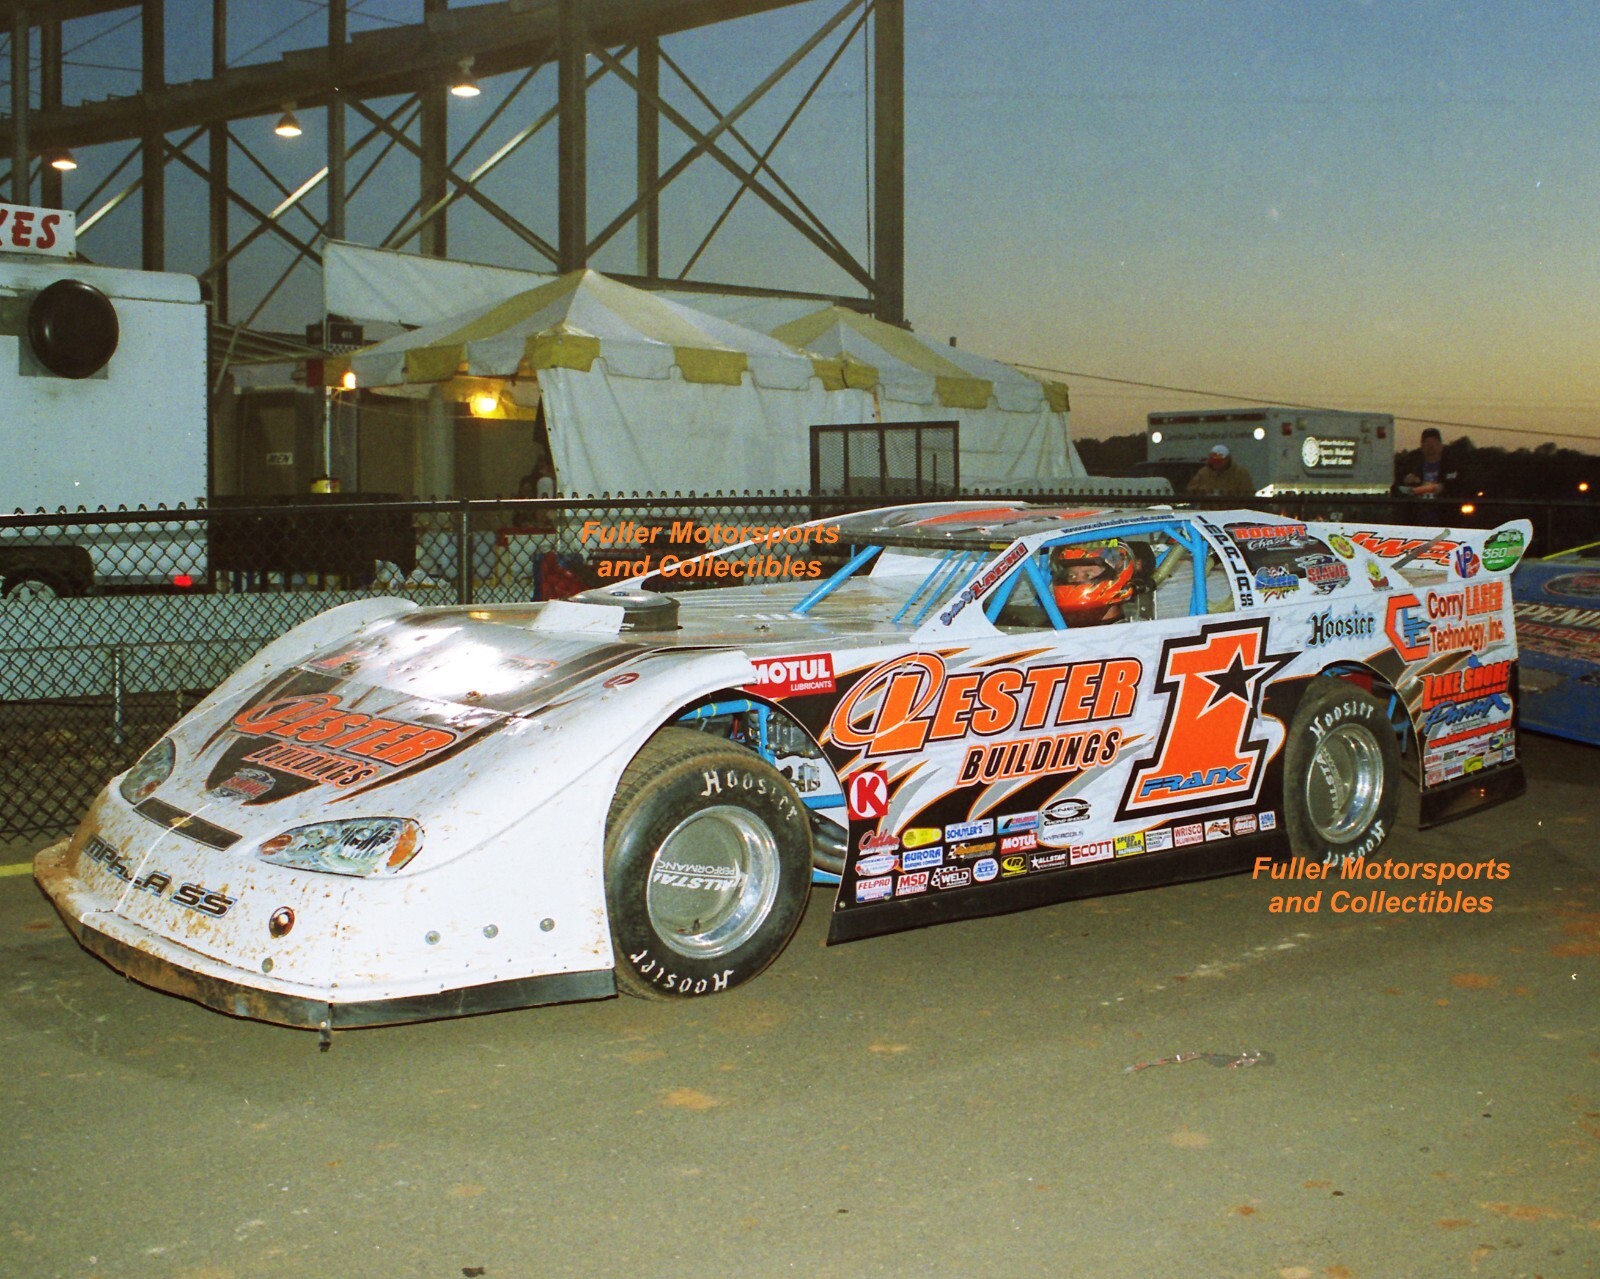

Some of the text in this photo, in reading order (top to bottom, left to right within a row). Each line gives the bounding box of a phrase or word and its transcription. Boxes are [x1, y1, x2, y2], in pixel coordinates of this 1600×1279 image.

[1233, 525, 1307, 540] ROCKET
[1197, 515, 1251, 591] IMPALA
[1482, 547, 1508, 559] 360
[1307, 564, 1349, 582] SLAVIC
[1240, 594, 1254, 607] SS
[1428, 582, 1503, 621] Corry LASER
[1306, 607, 1375, 647] Hoosier
[751, 658, 831, 686] MOTUL
[790, 680, 833, 692] LUBRICANTS
[830, 652, 1142, 759] LESTER
[233, 692, 457, 767] LESTER
[243, 743, 379, 788] BUILDINGS
[958, 727, 1122, 787] BUILDINGS
[1140, 763, 1249, 797] FRANK
[856, 775, 887, 817] K
[1001, 834, 1036, 850] MOTUL
[1175, 825, 1202, 837] WRISCO
[904, 848, 941, 863] AURORA
[1072, 841, 1112, 859] SCOTT
[900, 873, 927, 888] MSD
[942, 871, 969, 884] WELD
[171, 883, 237, 918] SS
